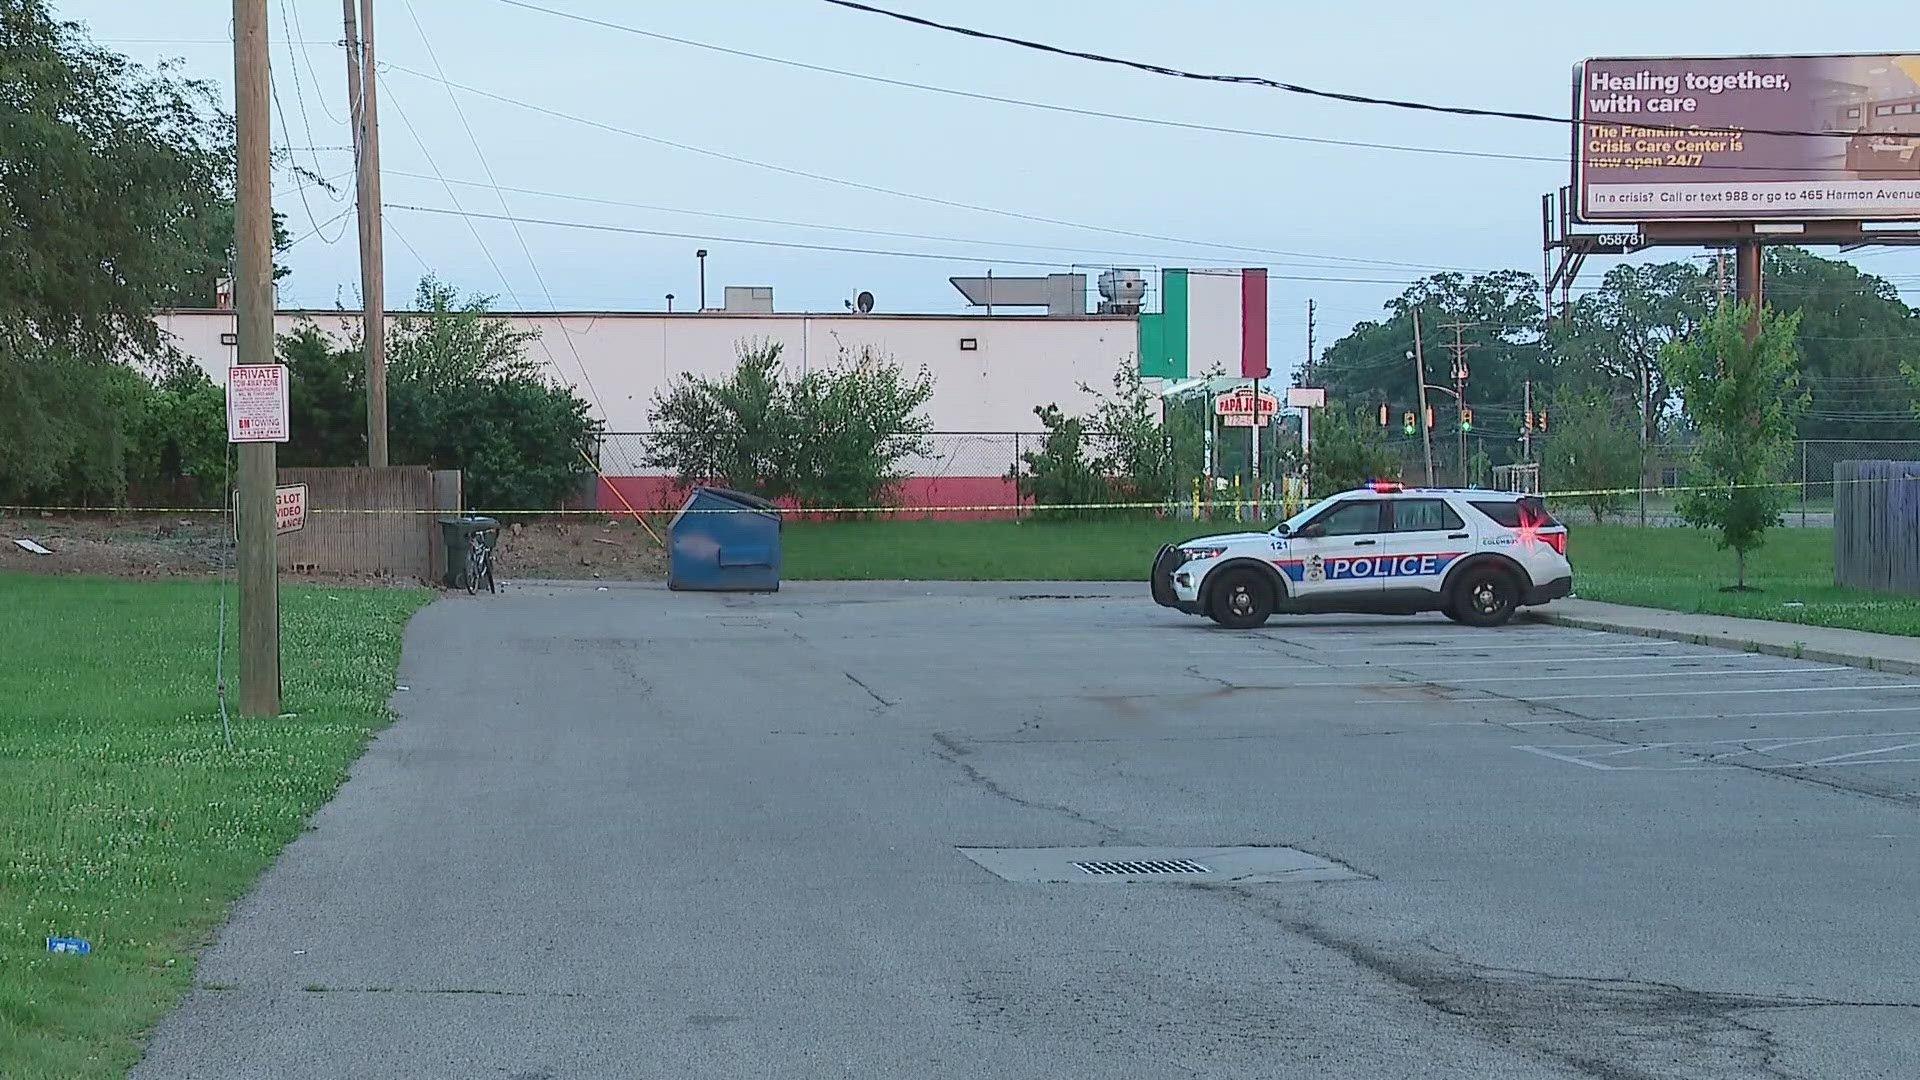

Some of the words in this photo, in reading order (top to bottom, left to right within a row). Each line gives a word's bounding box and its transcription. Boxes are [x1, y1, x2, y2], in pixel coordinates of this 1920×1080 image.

[1591, 71, 1679, 94] Healing
[1685, 71, 1790, 93] together,
[1590, 94, 1640, 112] with
[1647, 97, 1697, 112] care
[1590, 126, 1618, 137] The
[1622, 124, 1684, 137] Franklin
[1589, 139, 1632, 152] Crisis
[1635, 139, 1671, 152] Care
[1675, 139, 1727, 152] Center
[1730, 138, 1743, 152] is
[1590, 158, 1621, 167] now
[1625, 157, 1662, 170] open
[1667, 154, 1702, 167] 24/7
[1595, 193, 1606, 203] In
[1609, 195, 1615, 203] a
[1619, 192, 1654, 203] crisis?
[1660, 192, 1682, 202] Call
[1685, 193, 1698, 202] or
[1700, 192, 1722, 202] text
[1725, 191, 1748, 201] 988
[1751, 193, 1763, 201] or
[1767, 192, 1781, 203] go
[1785, 191, 1797, 200] to
[1800, 190, 1823, 200] 465
[1826, 190, 1873, 200] Harmon
[1876, 189, 1920, 200] Avenue
[1598, 233, 1645, 245] 058781
[233, 369, 279, 379] PRIVATE
[1220, 398, 1242, 411] PAPA
[284, 493, 300, 504] LOT
[1270, 541, 1288, 550] 121
[1333, 555, 1437, 578] POLICE
